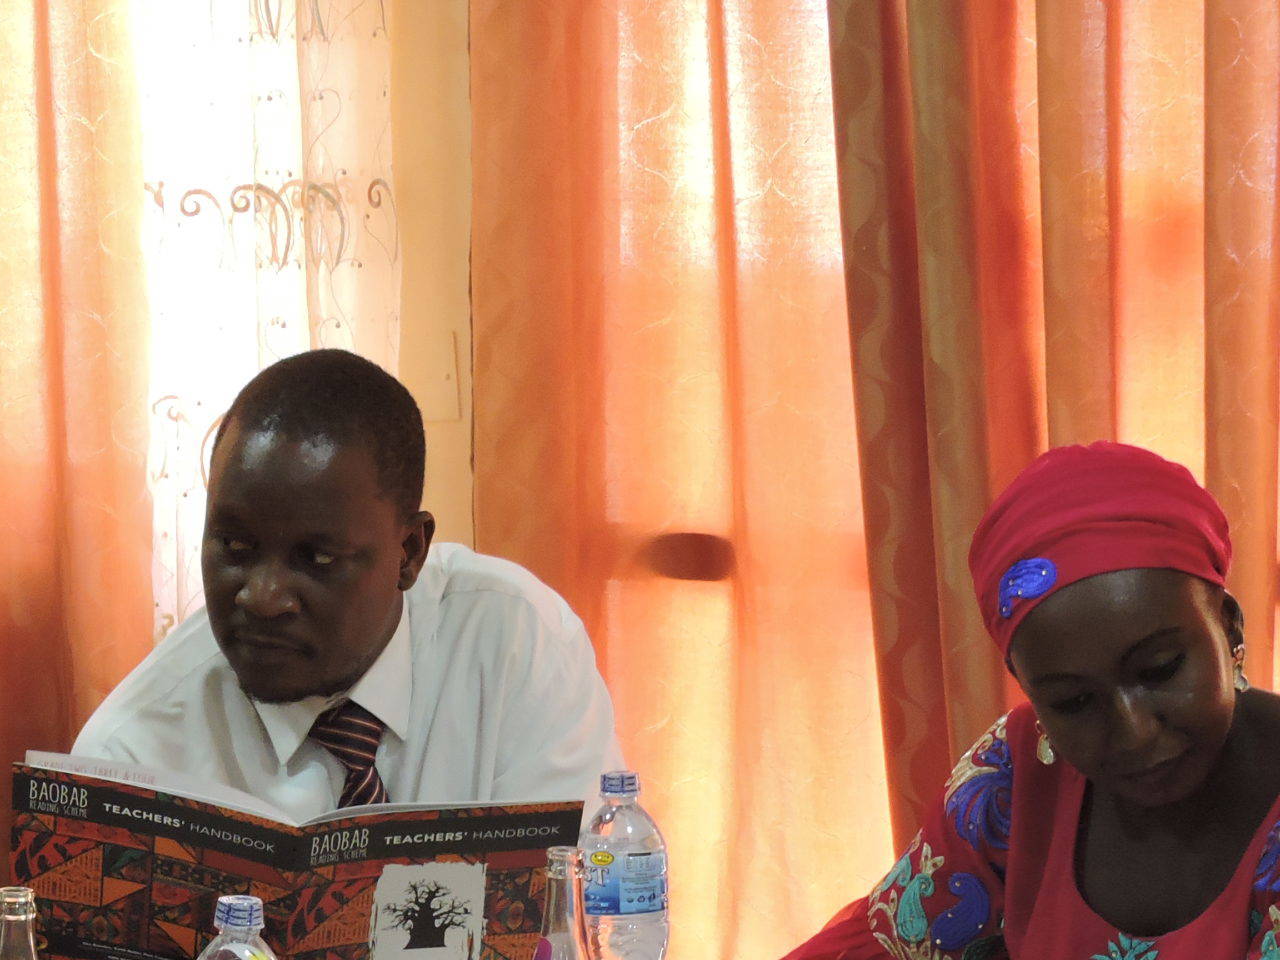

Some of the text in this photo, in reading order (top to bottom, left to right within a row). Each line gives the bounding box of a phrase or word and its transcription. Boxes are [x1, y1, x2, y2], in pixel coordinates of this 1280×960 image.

[29, 779, 88, 808] BAOBAB
[29, 801, 88, 819] READING SCHEME
[103, 803, 275, 853] TEACHERS' HANDBOOK
[384, 825, 561, 845] TEACHERS' HANDBOOK
[311, 828, 369, 857] BAOBAB
[310, 849, 368, 866] READING SCHEME
